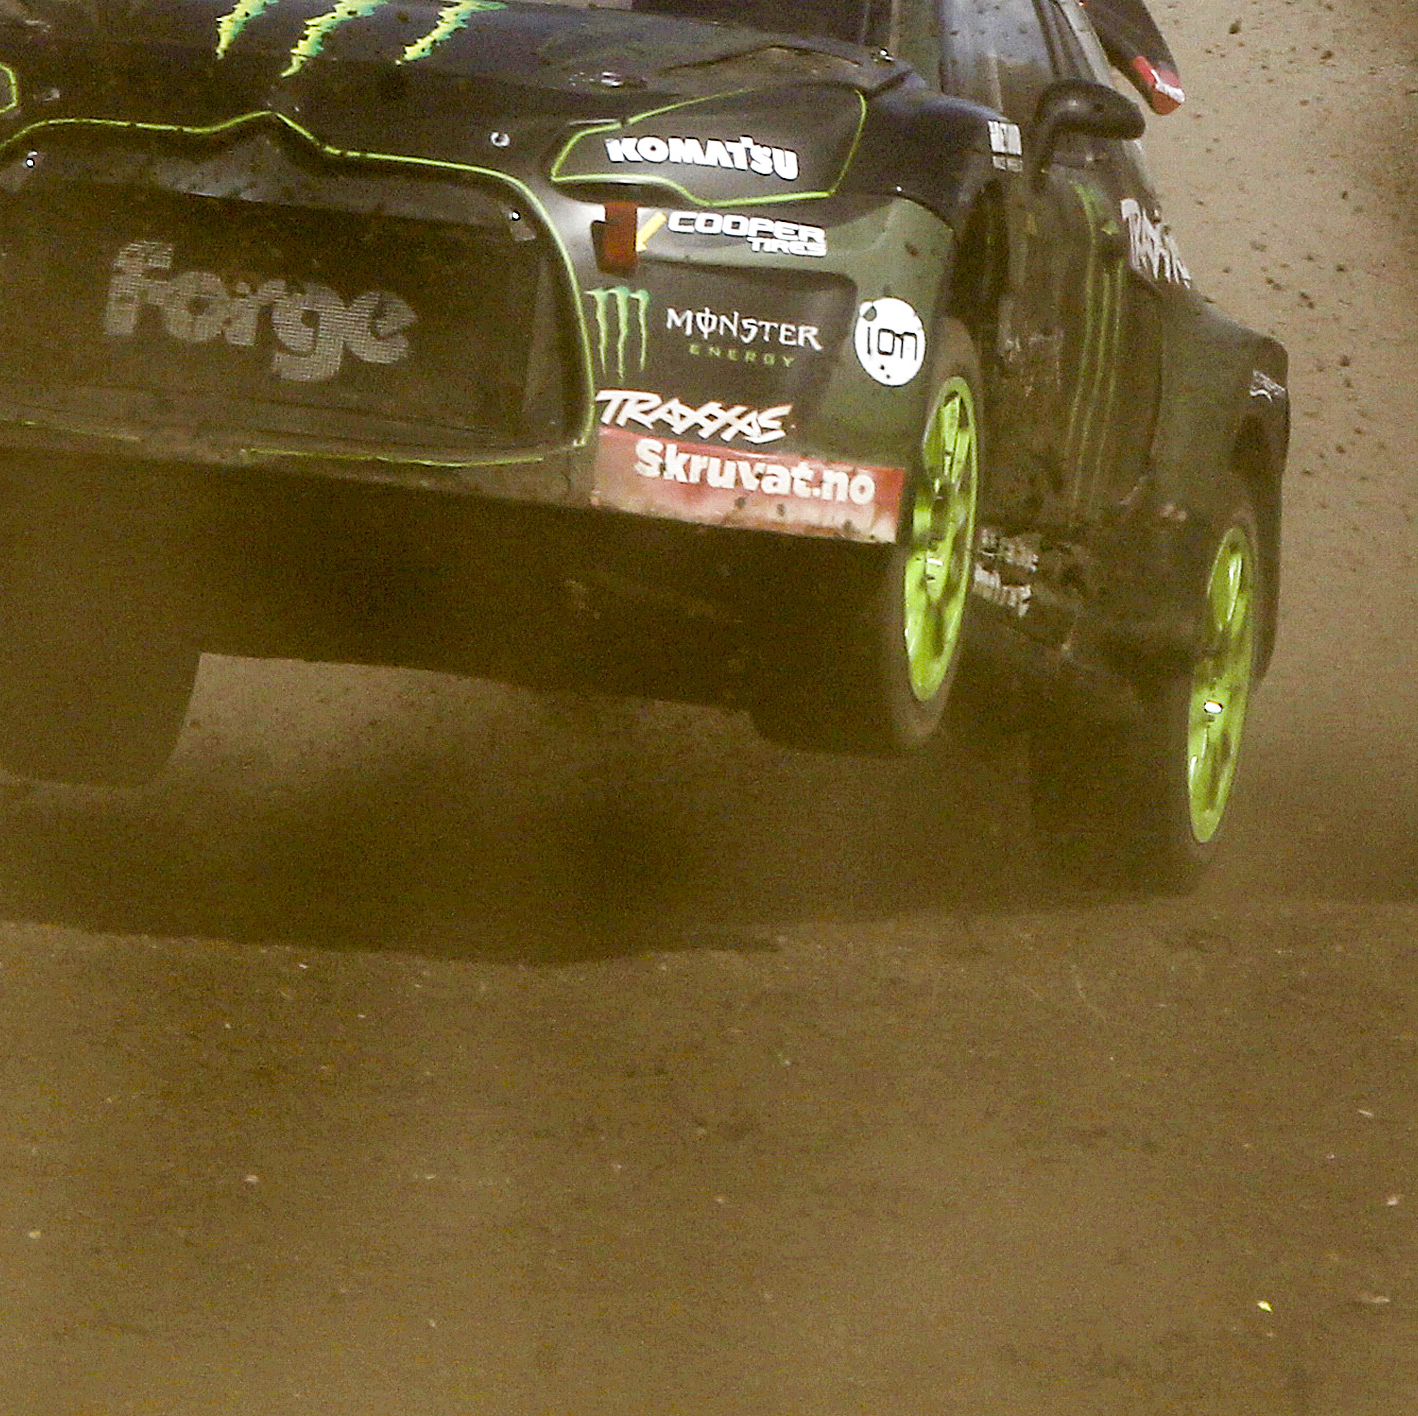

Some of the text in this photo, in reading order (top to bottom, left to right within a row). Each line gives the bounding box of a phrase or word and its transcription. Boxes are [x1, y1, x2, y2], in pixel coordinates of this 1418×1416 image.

[605, 135, 800, 180] KOMATSU
[667, 210, 826, 243] COOPER
[747, 234, 827, 257] TIRES
[690, 344, 795, 368] ENERGY
[595, 388, 793, 444] TRAXXAS
[634, 438, 876, 506] Skruvat.no
